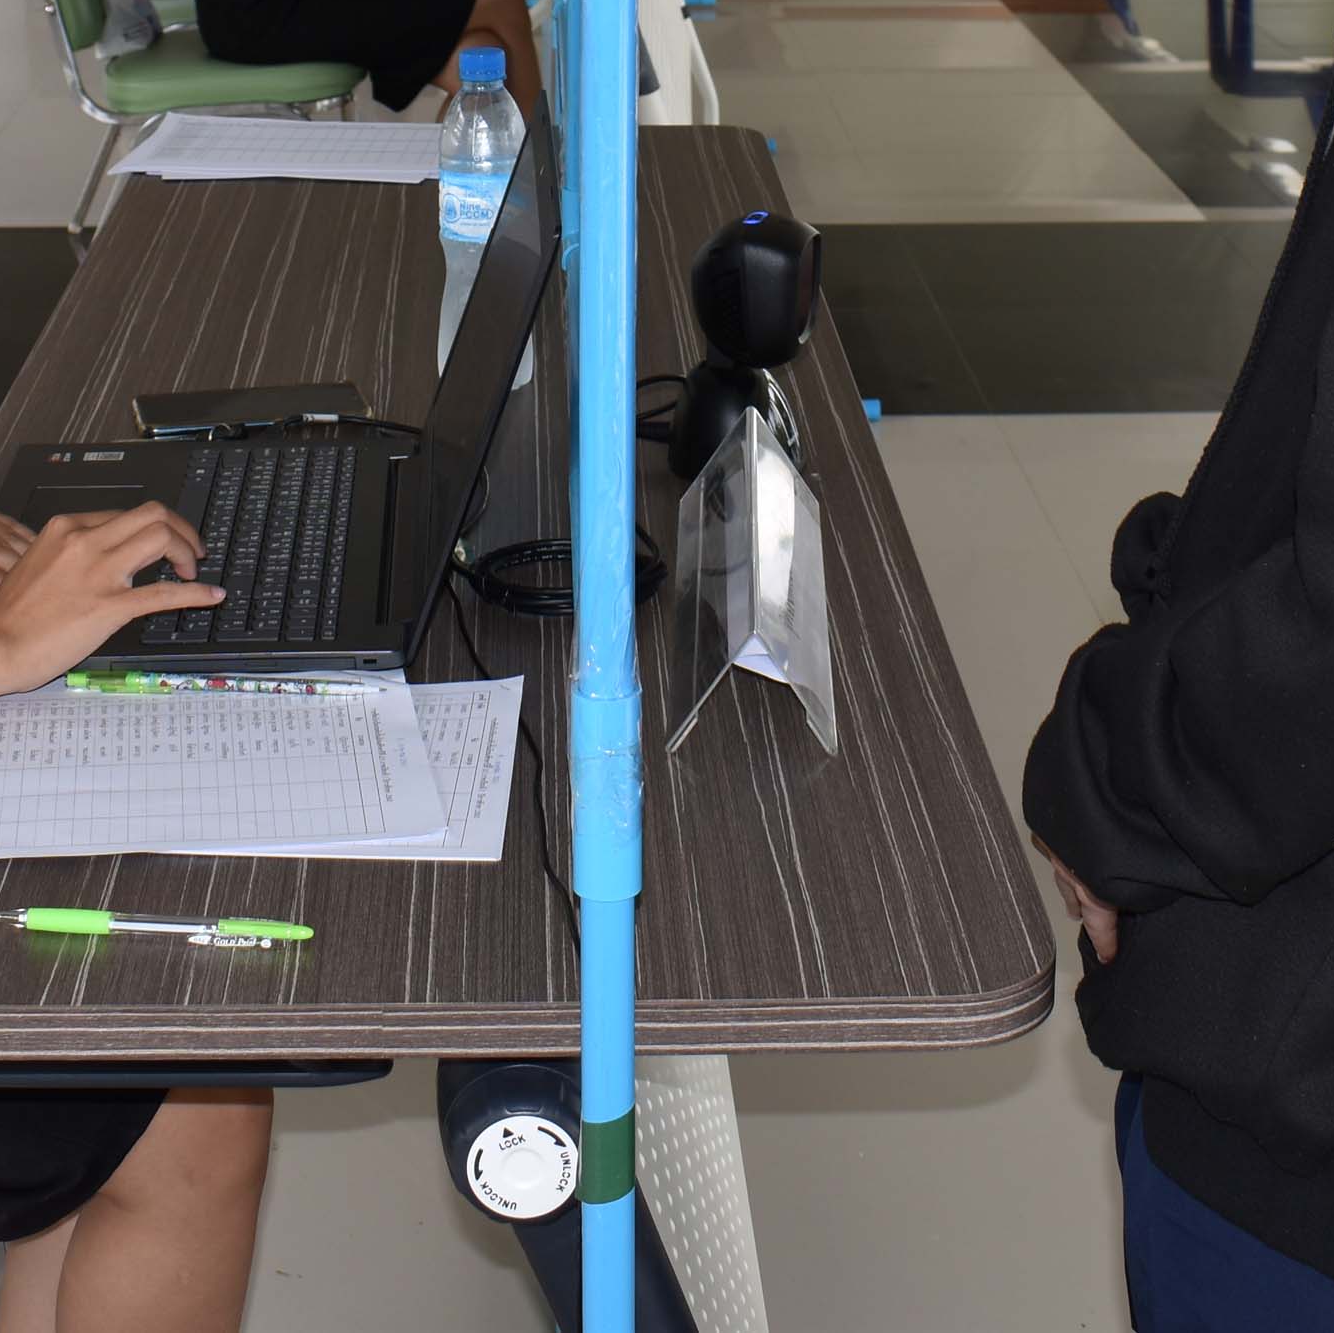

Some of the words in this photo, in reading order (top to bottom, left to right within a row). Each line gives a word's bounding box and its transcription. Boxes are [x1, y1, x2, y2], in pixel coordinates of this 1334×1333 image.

[499, 1134, 526, 1151] LOCK
[555, 1151, 571, 1193] UNLOCK
[480, 1181, 517, 1210] UNLOCK
